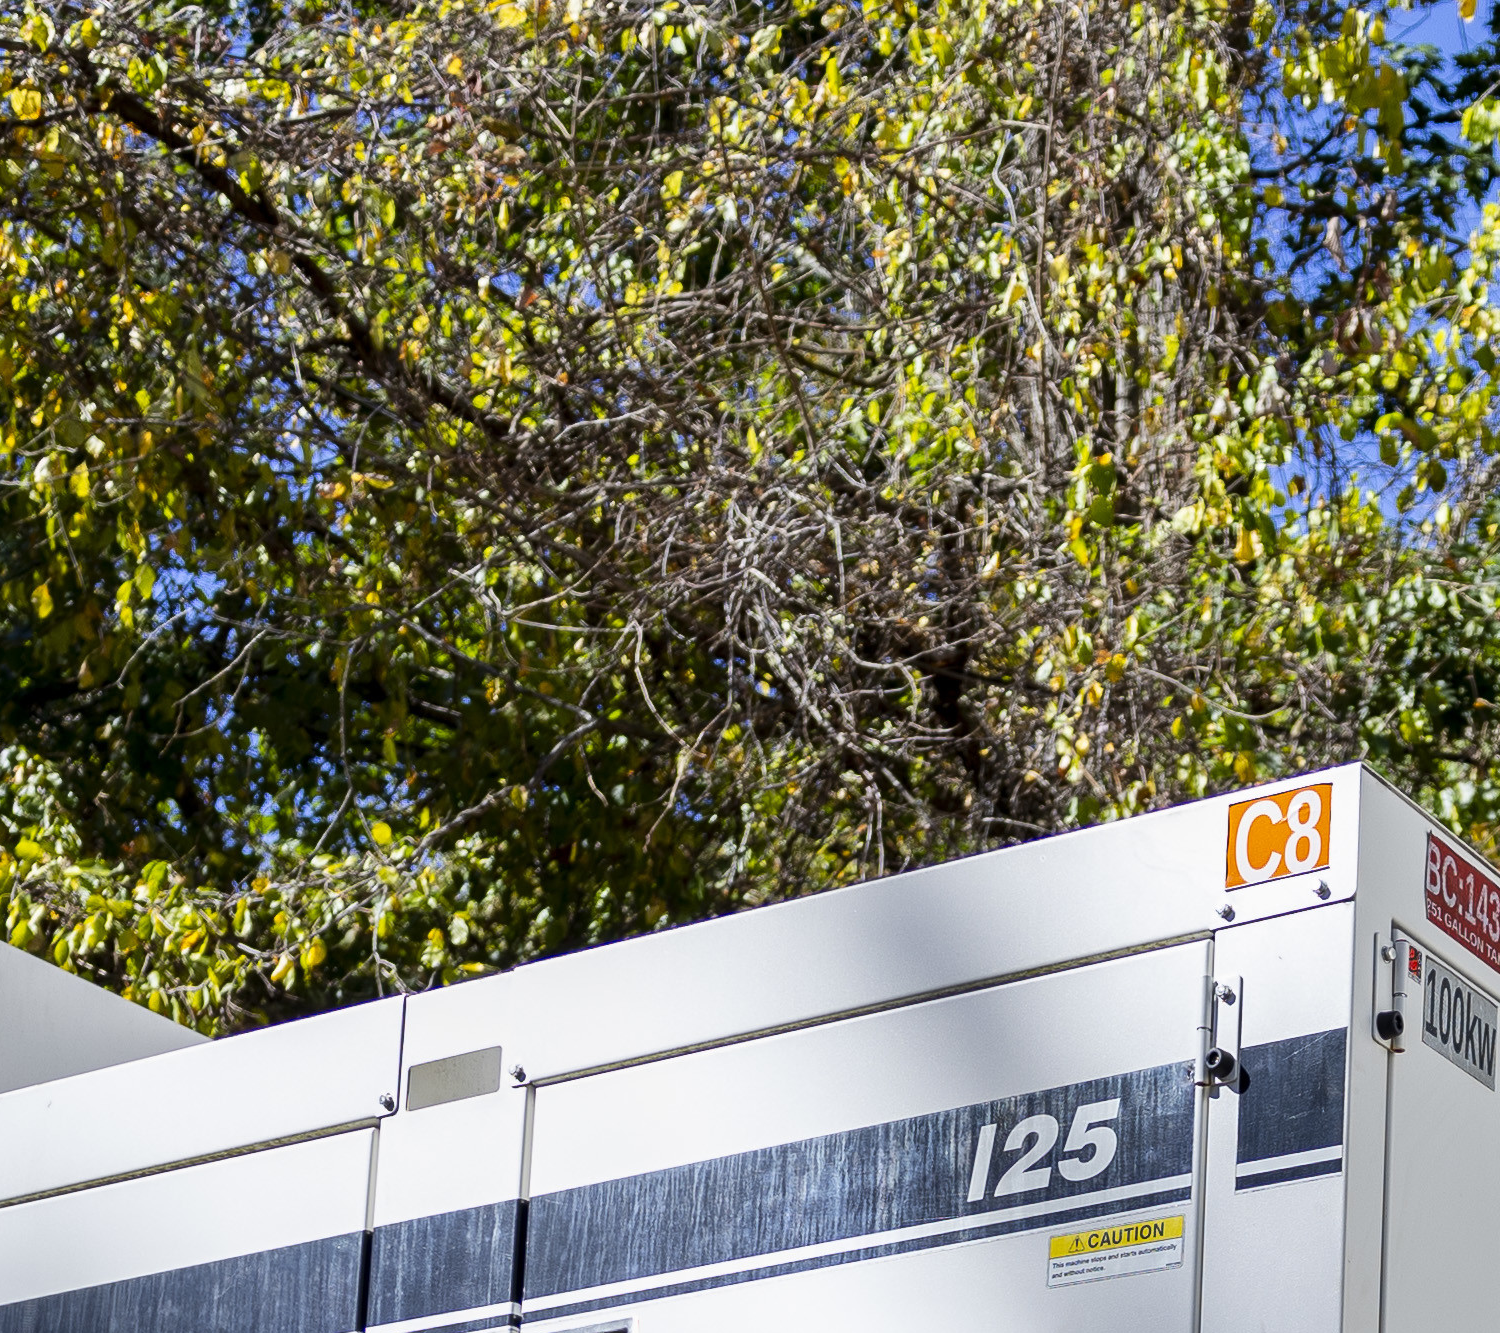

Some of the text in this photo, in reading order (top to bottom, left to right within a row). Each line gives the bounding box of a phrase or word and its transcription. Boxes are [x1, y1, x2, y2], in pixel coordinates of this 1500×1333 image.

[1236, 790, 1322, 883] C8
[1444, 914, 1484, 953] GALLON
[967, 1098, 1121, 1202] 125
[1087, 1222, 1165, 1249] CAUTION
